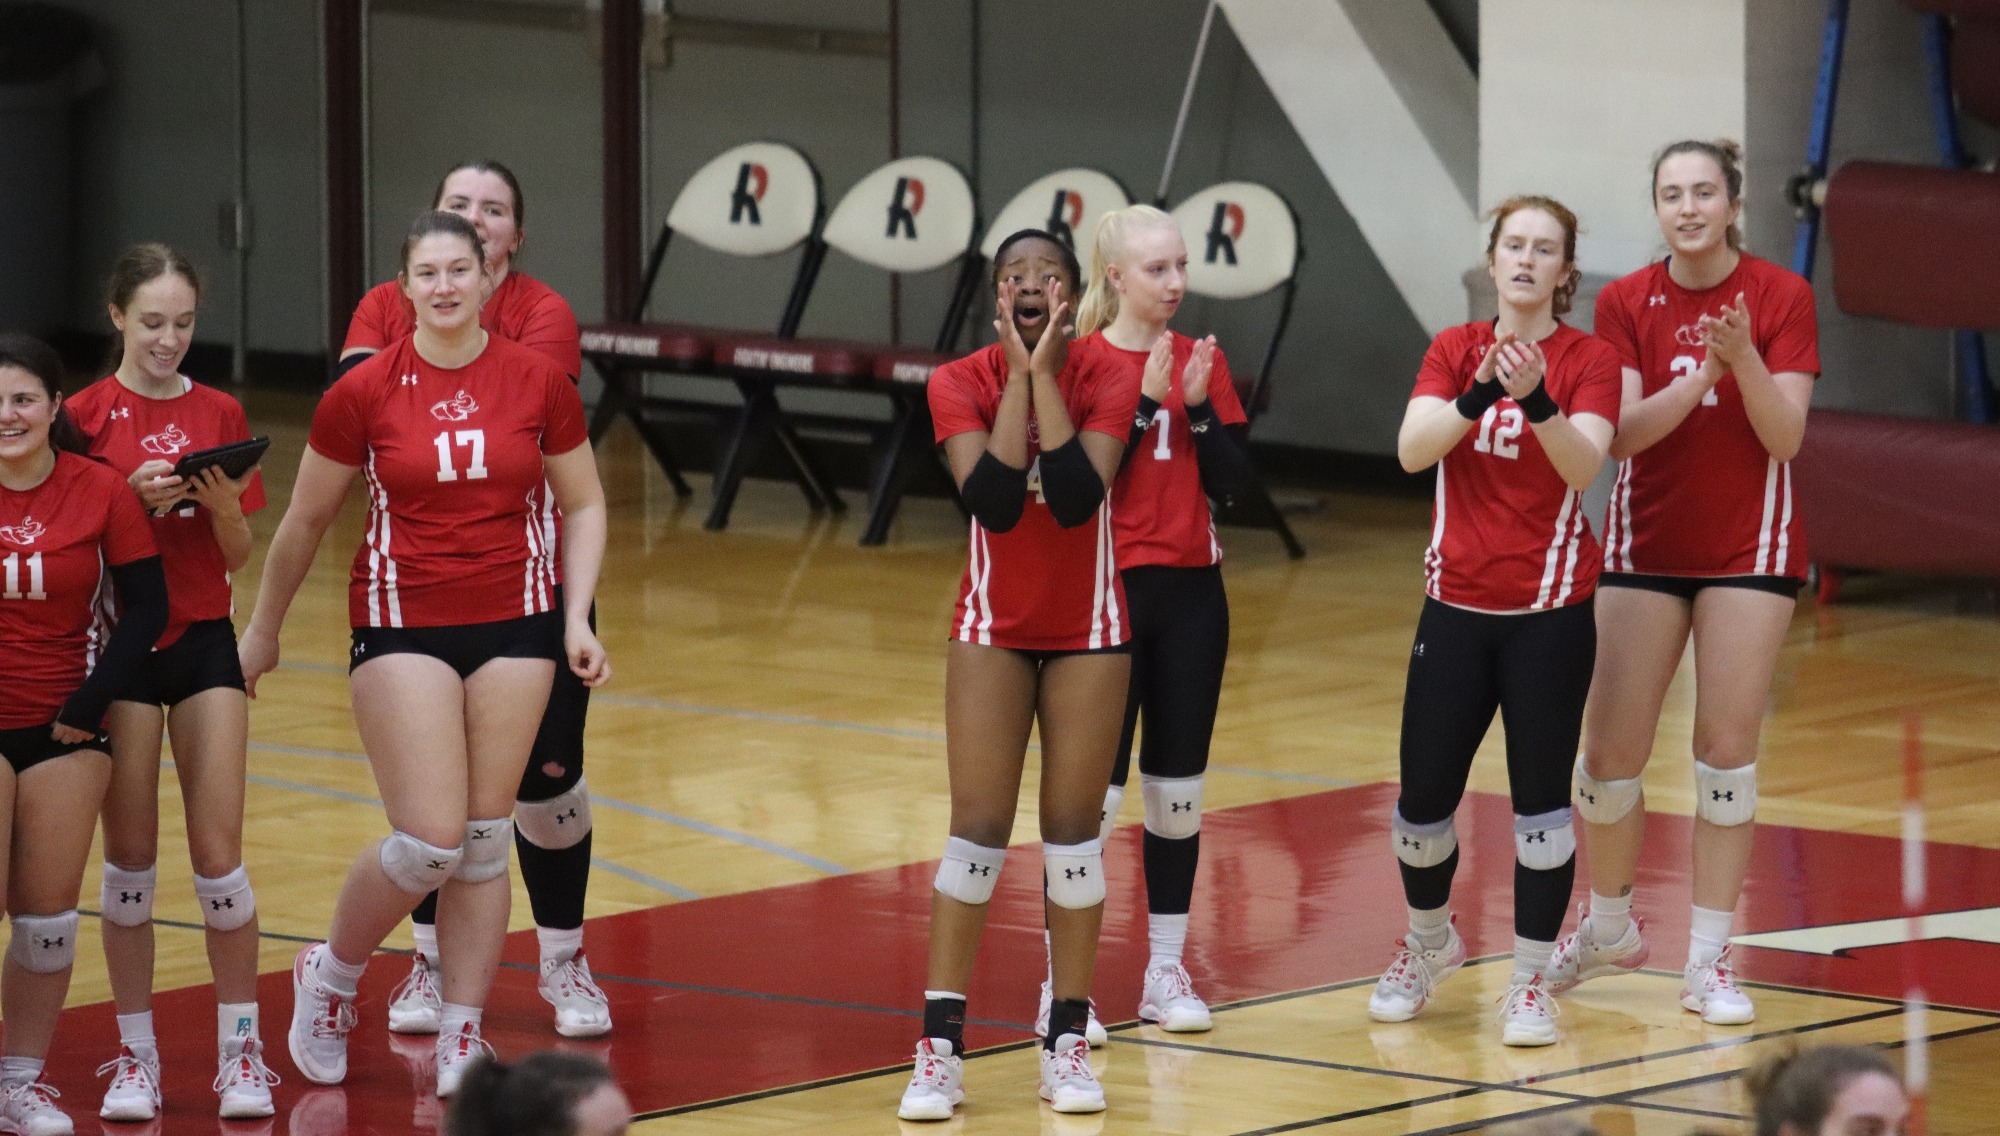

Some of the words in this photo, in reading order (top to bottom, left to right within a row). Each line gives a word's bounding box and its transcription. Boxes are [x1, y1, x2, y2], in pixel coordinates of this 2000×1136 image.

[433, 429, 488, 482] 17
[1474, 405, 1523, 460] 12
[2, 551, 47, 600] 11
